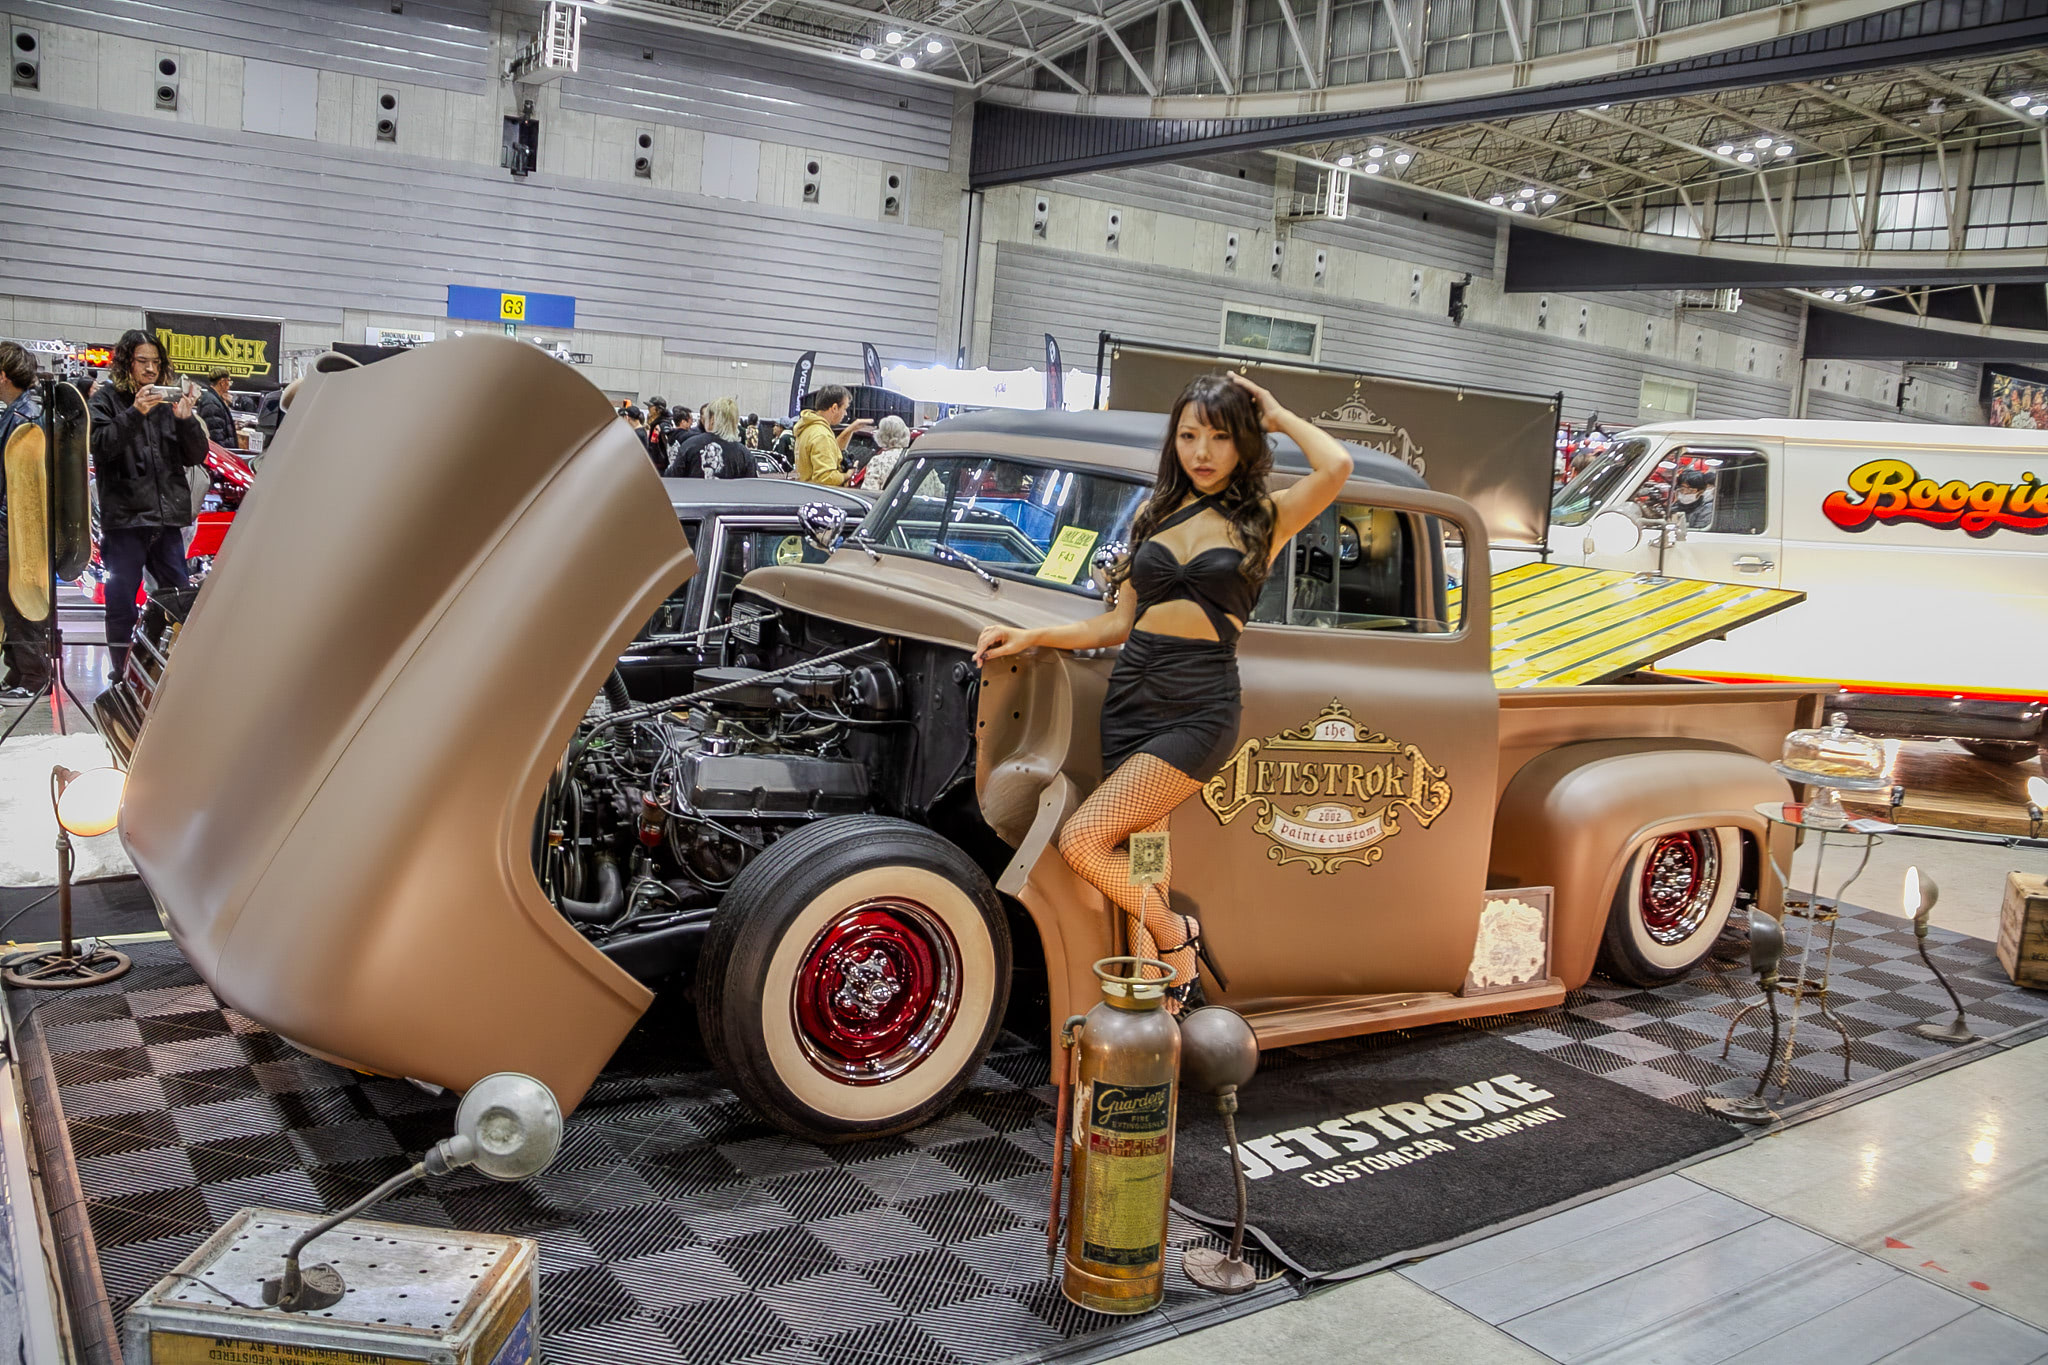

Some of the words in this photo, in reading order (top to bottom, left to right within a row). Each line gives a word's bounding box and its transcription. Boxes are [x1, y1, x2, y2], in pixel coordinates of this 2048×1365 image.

[503, 299, 523, 315] G3
[381, 331, 405, 339] SMOKING
[407, 333, 421, 341] AREA
[173, 362, 206, 371] STREET
[1347, 409, 1362, 421] the
[1057, 551, 1075, 562] F43
[1325, 723, 1346, 739] the
[1318, 812, 1342, 822] 2002
[1223, 1074, 1555, 1180] JETSTROKE
[1456, 1106, 1567, 1144] COMPANY
[215, 1338, 239, 1349] LAW
[250, 1342, 264, 1352] BY
[209, 1350, 272, 1365] REGISTERED
